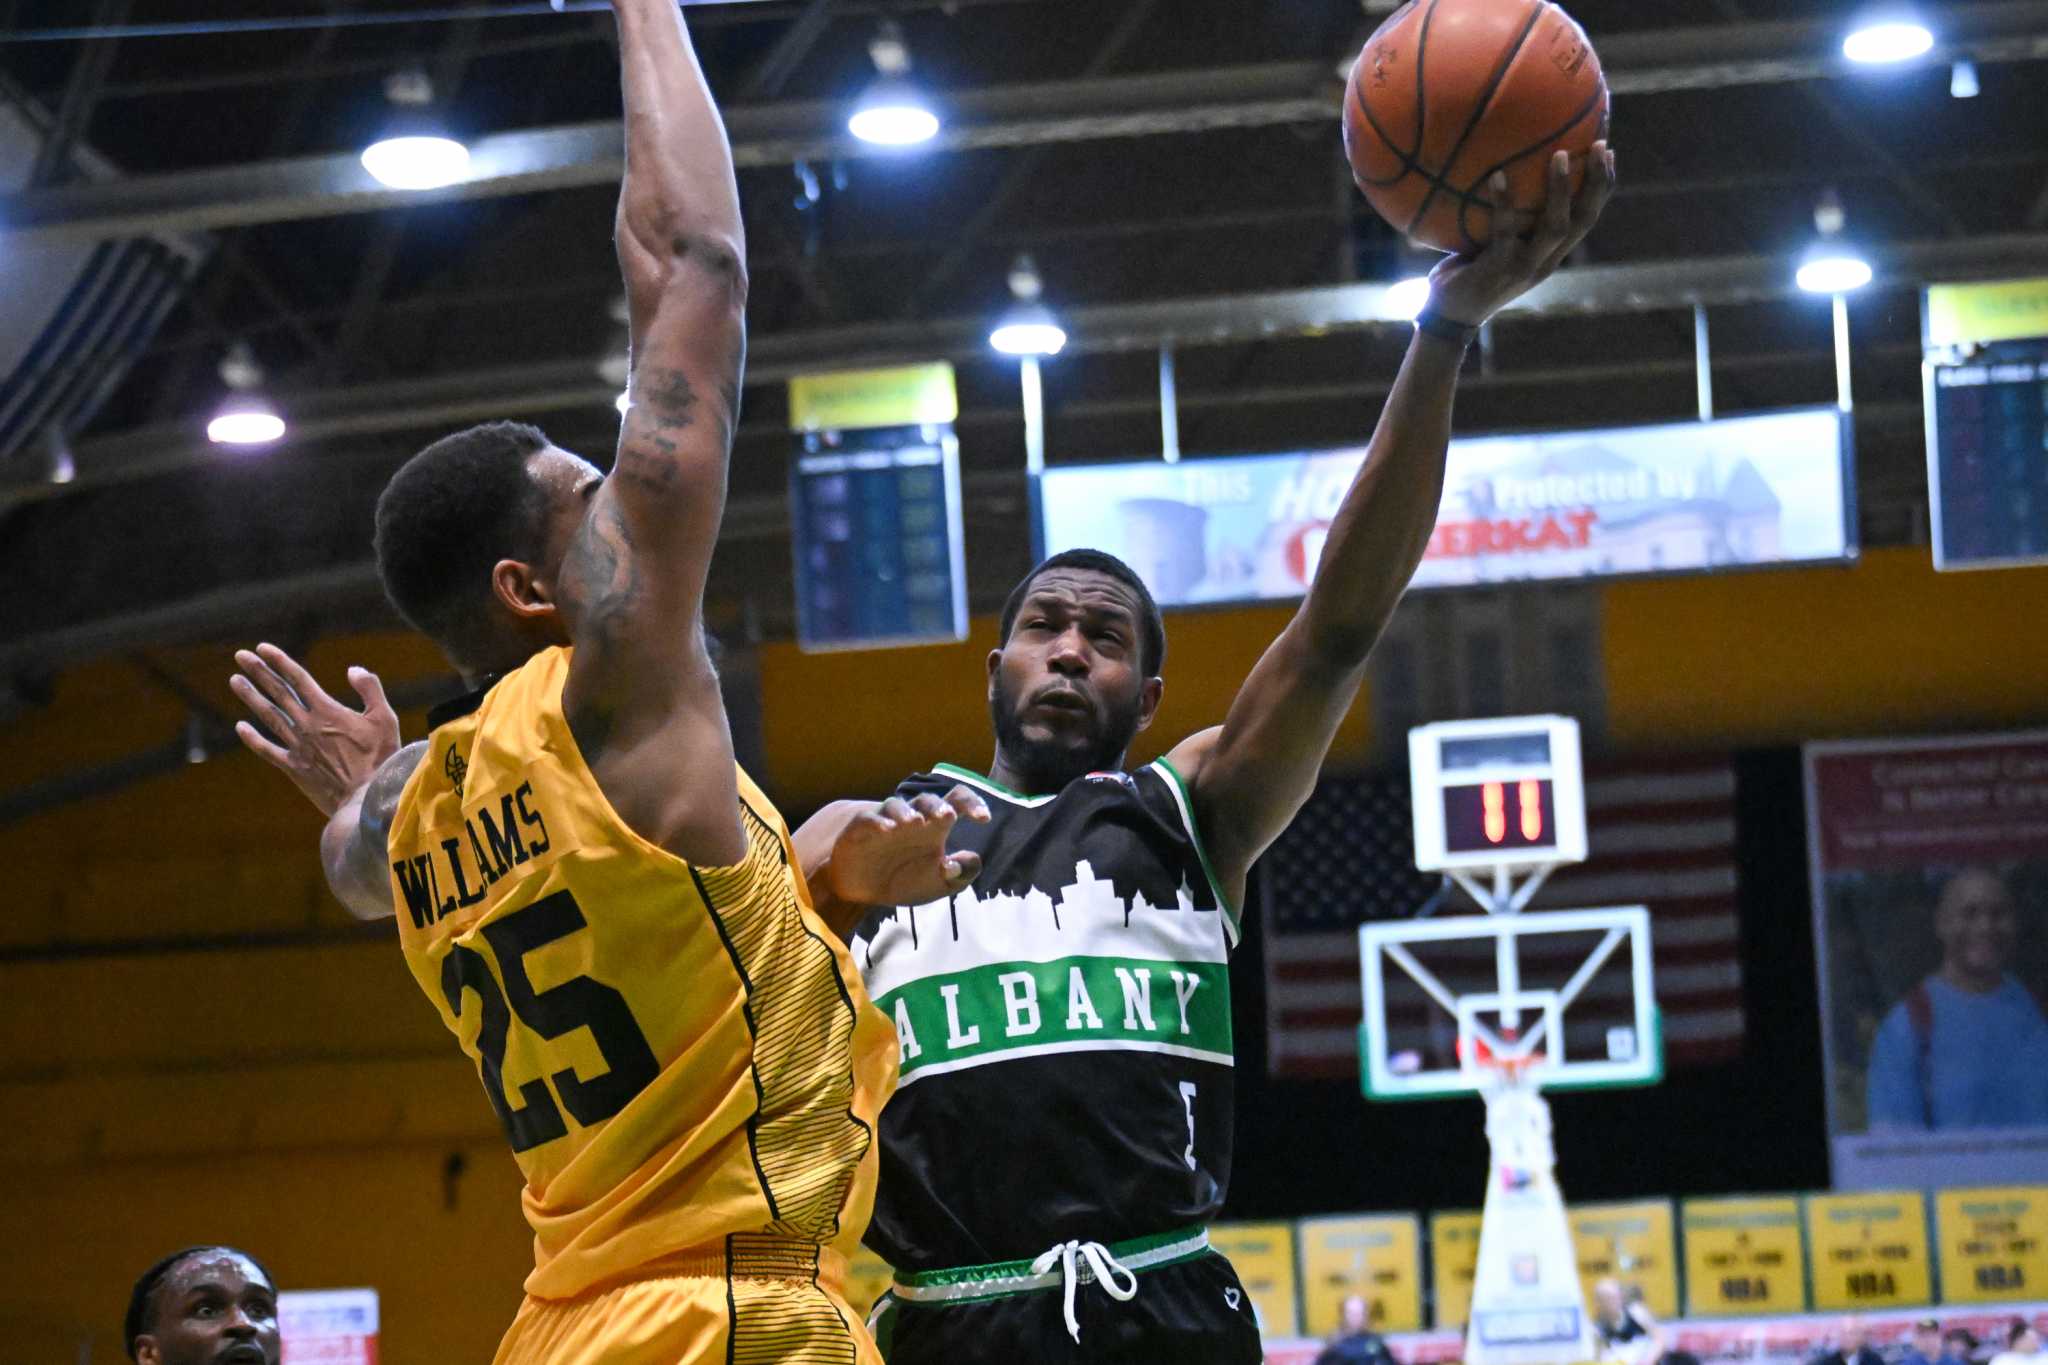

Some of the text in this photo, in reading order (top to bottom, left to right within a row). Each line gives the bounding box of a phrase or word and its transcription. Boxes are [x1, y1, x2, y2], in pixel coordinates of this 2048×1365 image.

[1480, 778, 1543, 843] 11
[440, 888, 661, 1154] 25
[894, 966, 1200, 1064] ALBANY
